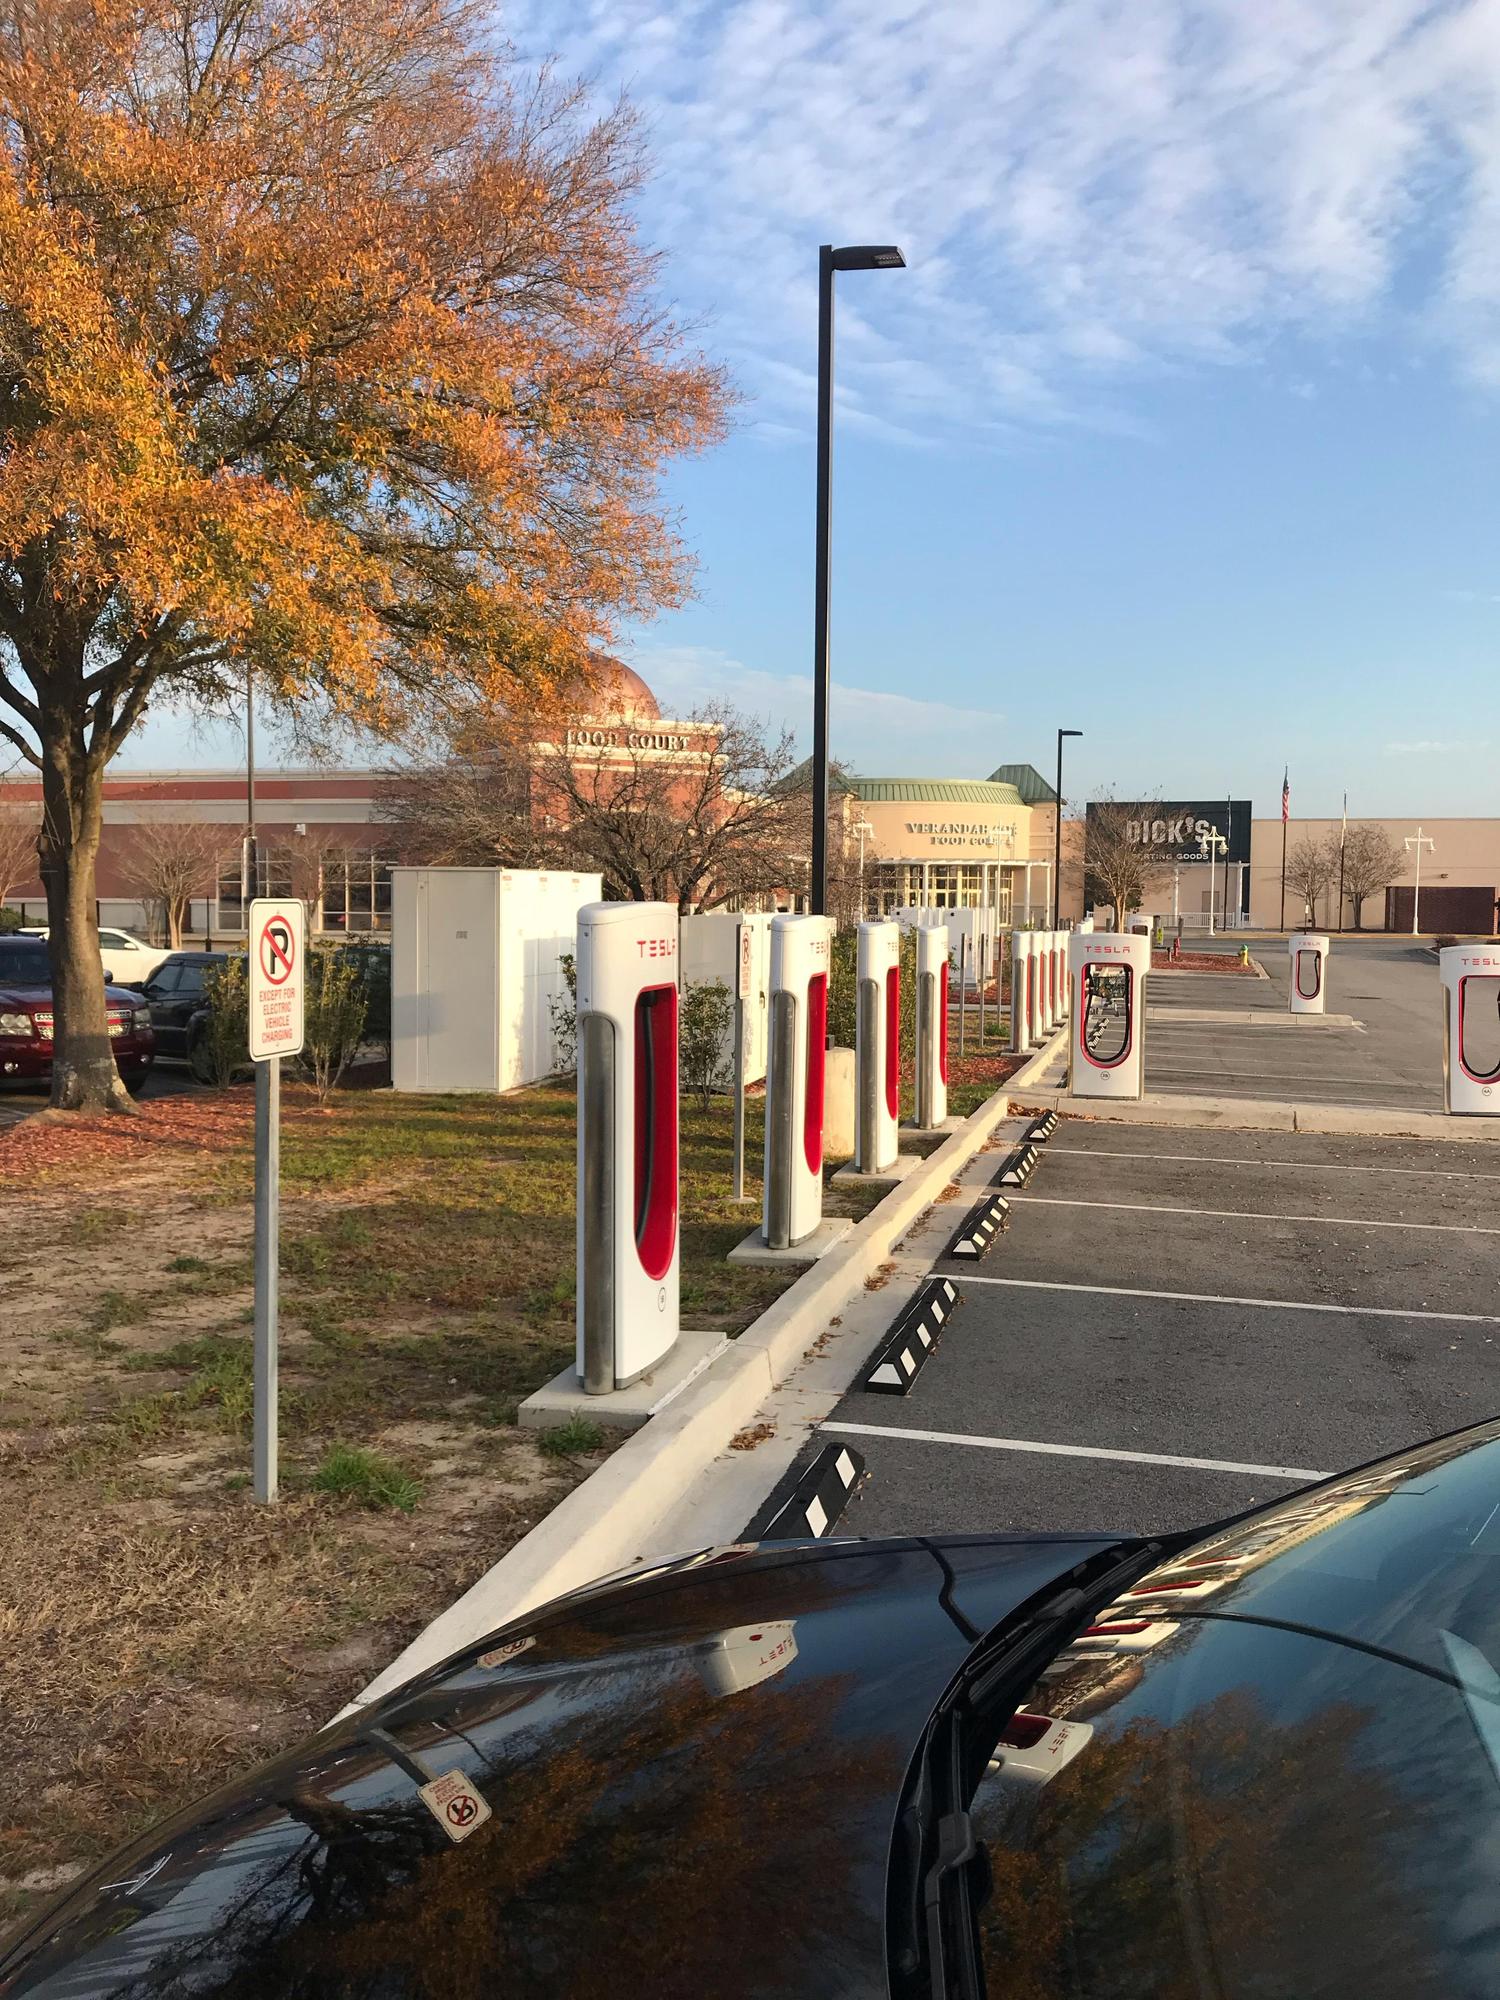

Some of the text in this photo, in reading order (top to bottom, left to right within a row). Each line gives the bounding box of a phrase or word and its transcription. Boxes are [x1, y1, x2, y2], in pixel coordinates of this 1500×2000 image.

[628, 733, 690, 750] COURT
[1127, 816, 1210, 844] DICK'S
[930, 836, 966, 846] FOOD
[1176, 853, 1209, 861] GOODS
[259, 987, 295, 1002] EXCEPT FOR
[263, 1001, 291, 1015] ELECTRIC
[265, 1015, 290, 1029] VEHICLE
[261, 1028, 293, 1043] CHARGING
